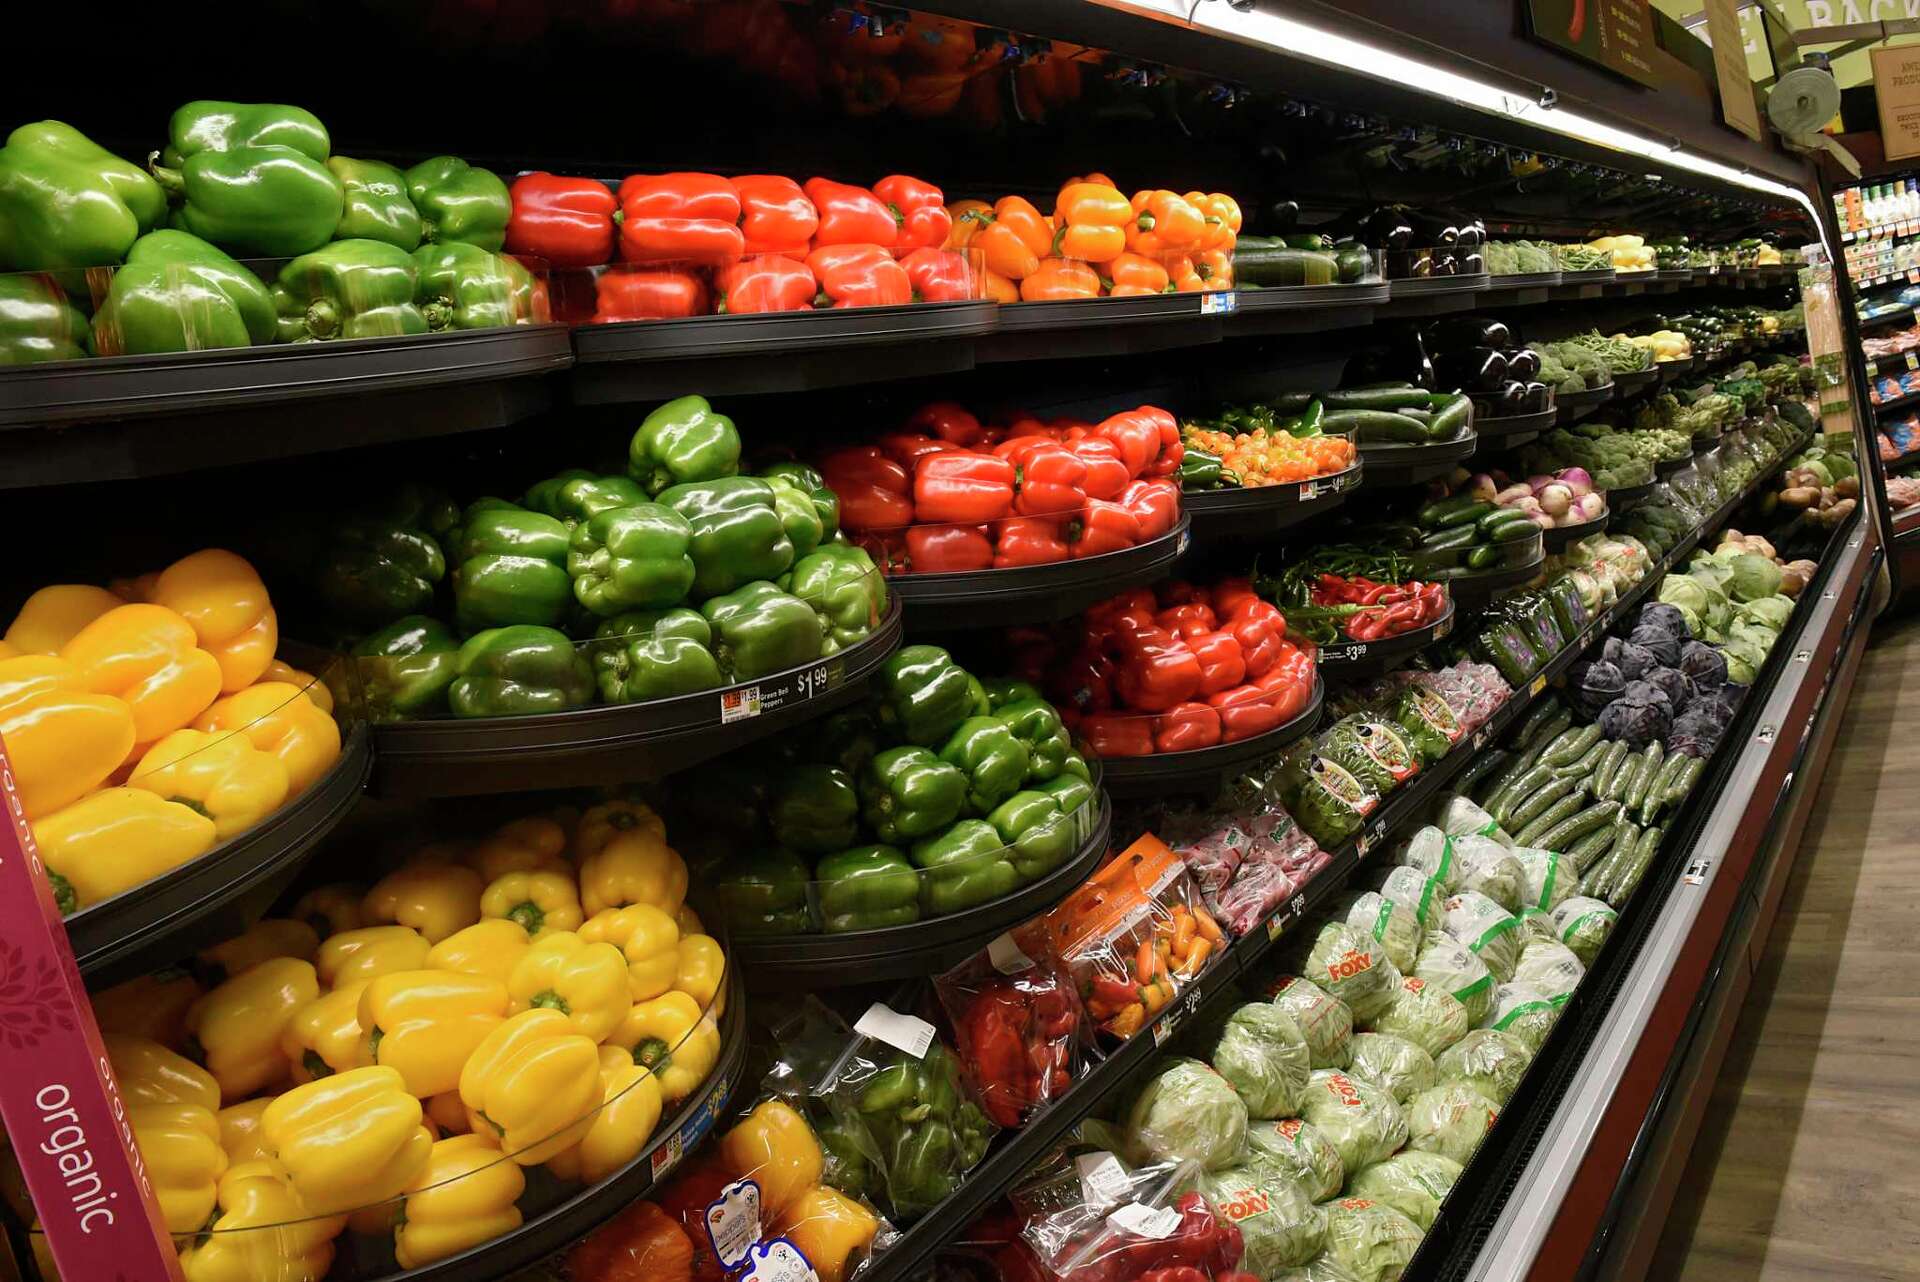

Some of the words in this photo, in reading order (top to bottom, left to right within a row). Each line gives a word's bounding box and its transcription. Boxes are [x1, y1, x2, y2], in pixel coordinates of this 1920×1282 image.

[760, 692, 777, 702] Green
[778, 687, 789, 697] Bell
[760, 698, 783, 708] Peppers
[0, 754, 43, 875] rganic
[1328, 952, 1372, 983] FOXY
[36, 1084, 119, 1234] organic
[100, 1057, 150, 1199] organic
